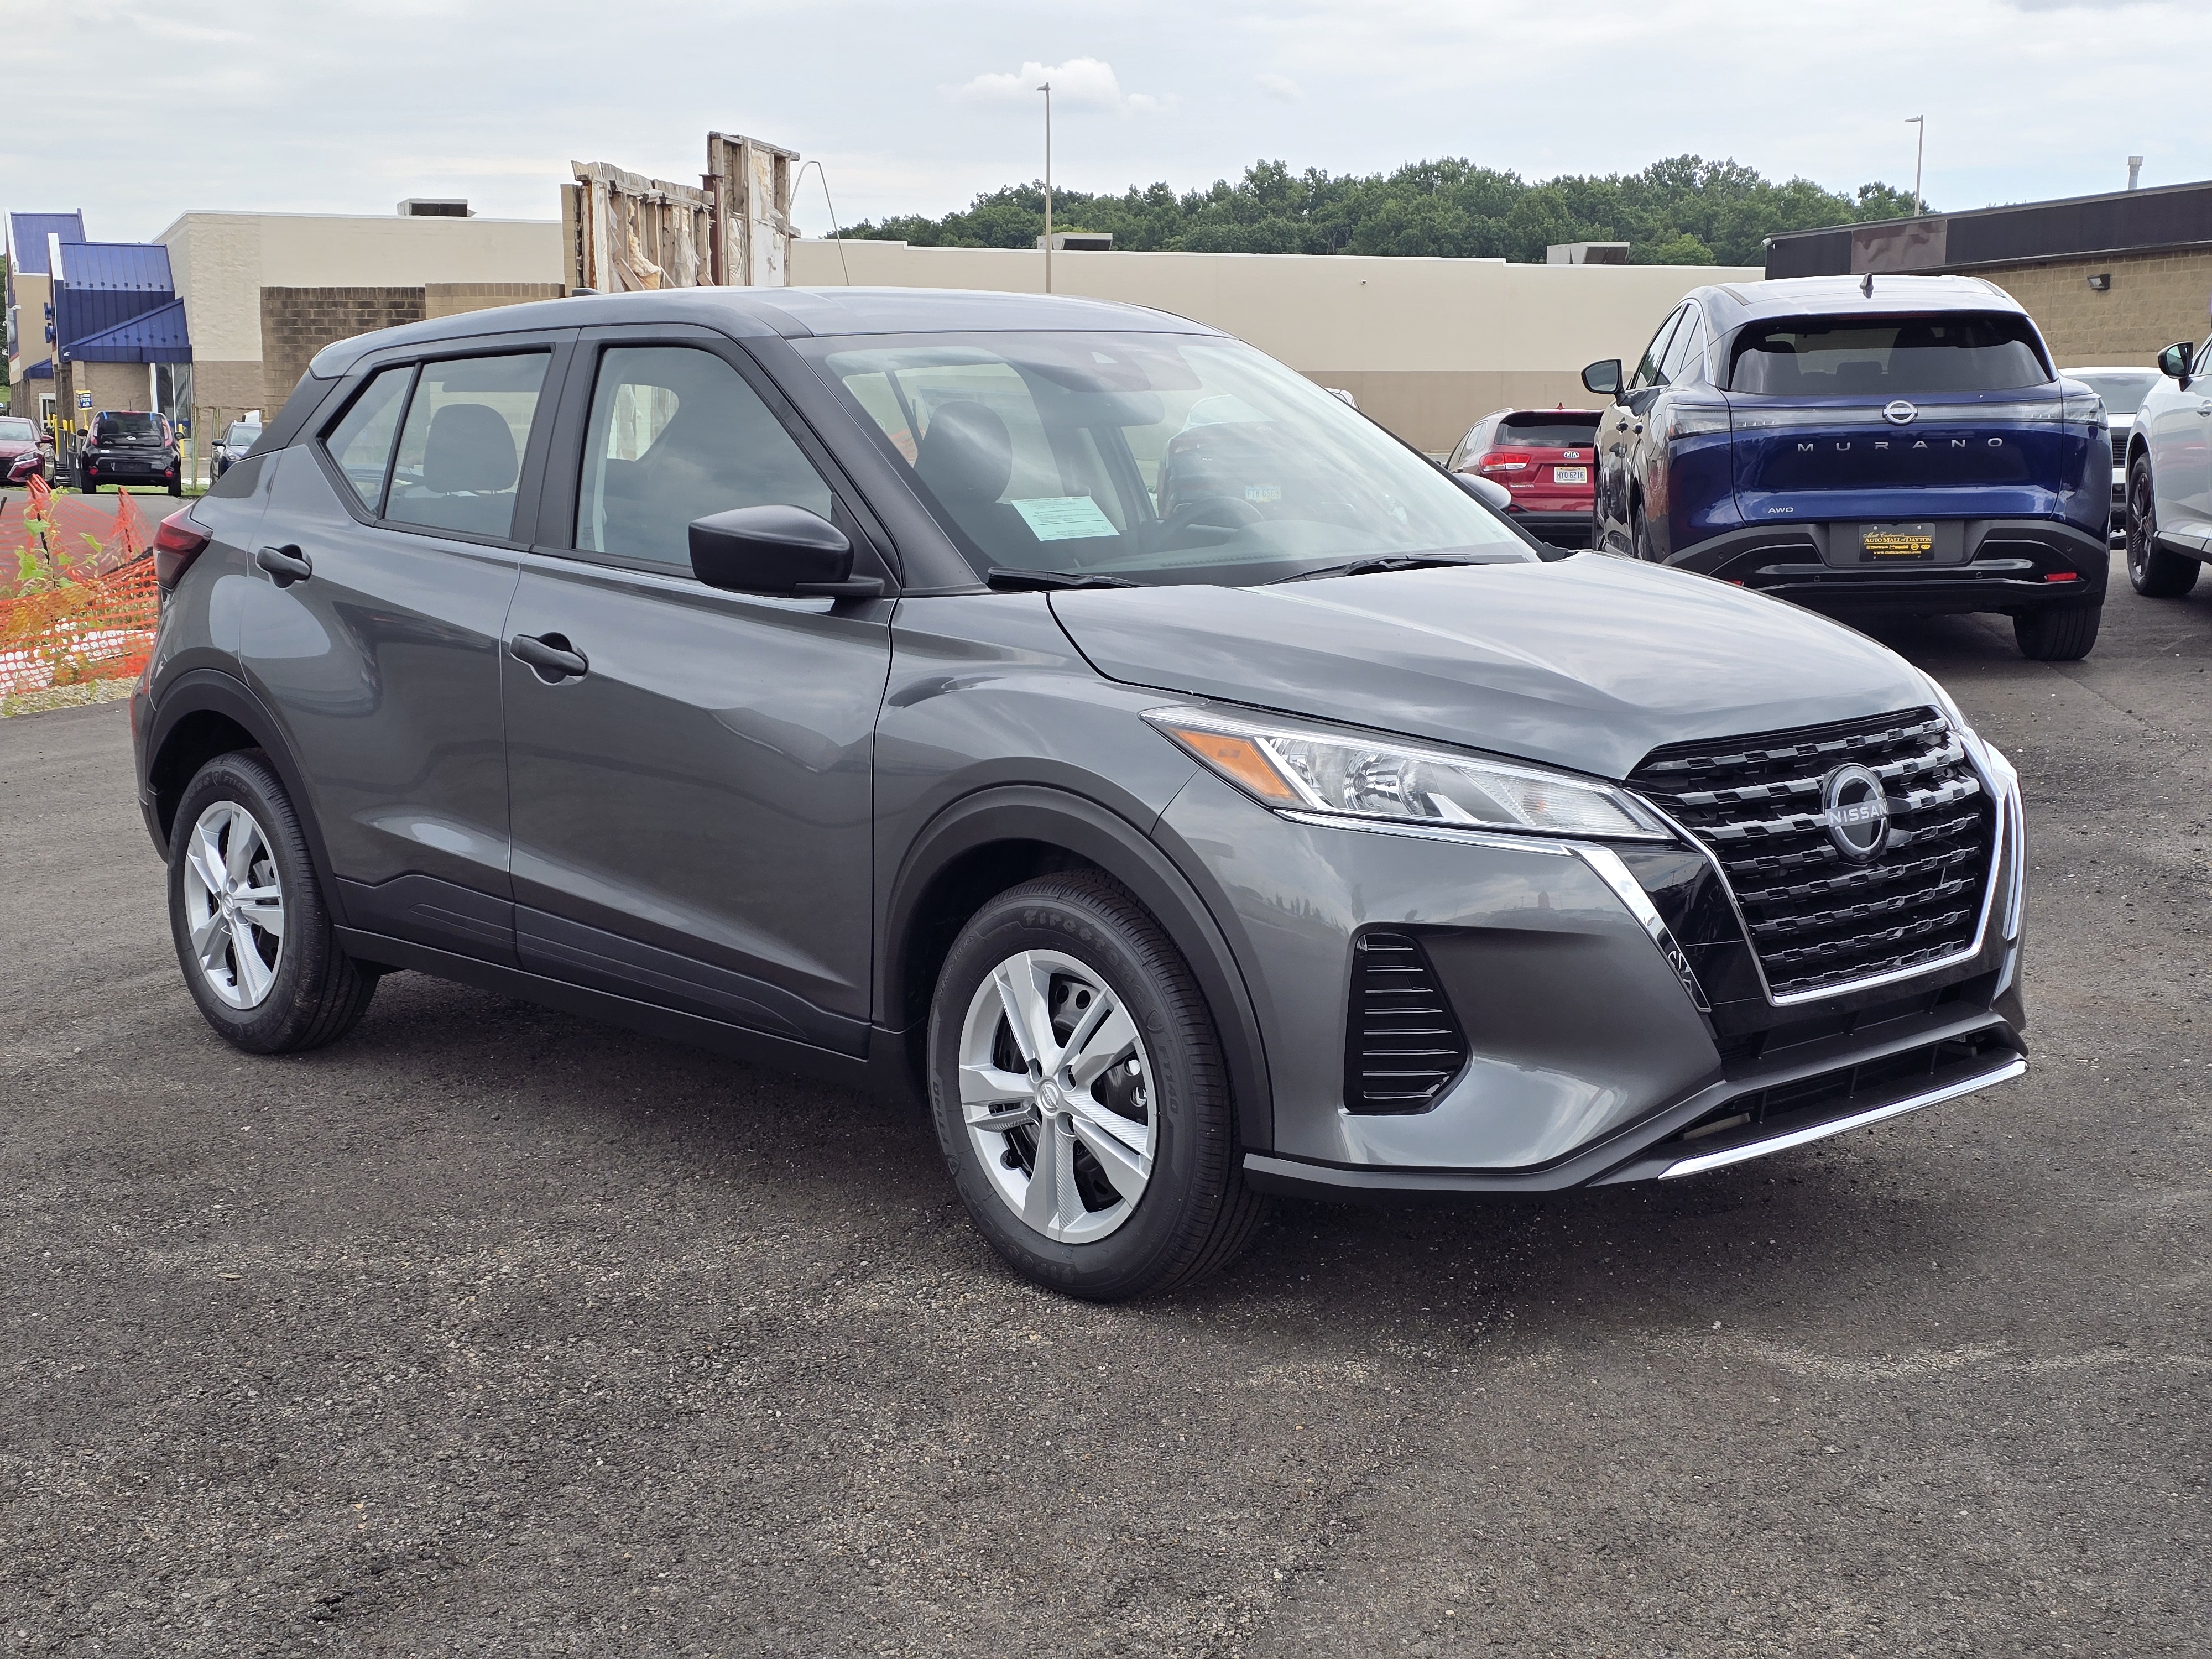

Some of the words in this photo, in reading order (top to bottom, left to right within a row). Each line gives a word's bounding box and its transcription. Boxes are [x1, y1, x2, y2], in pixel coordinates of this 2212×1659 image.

[1797, 437, 2002, 452] MURANO
[1569, 471, 1584, 479] 6216
[1262, 488, 1280, 498] 6569
[1829, 804, 1887, 824] NISSAN
[1158, 1045, 1180, 1115] FT140
